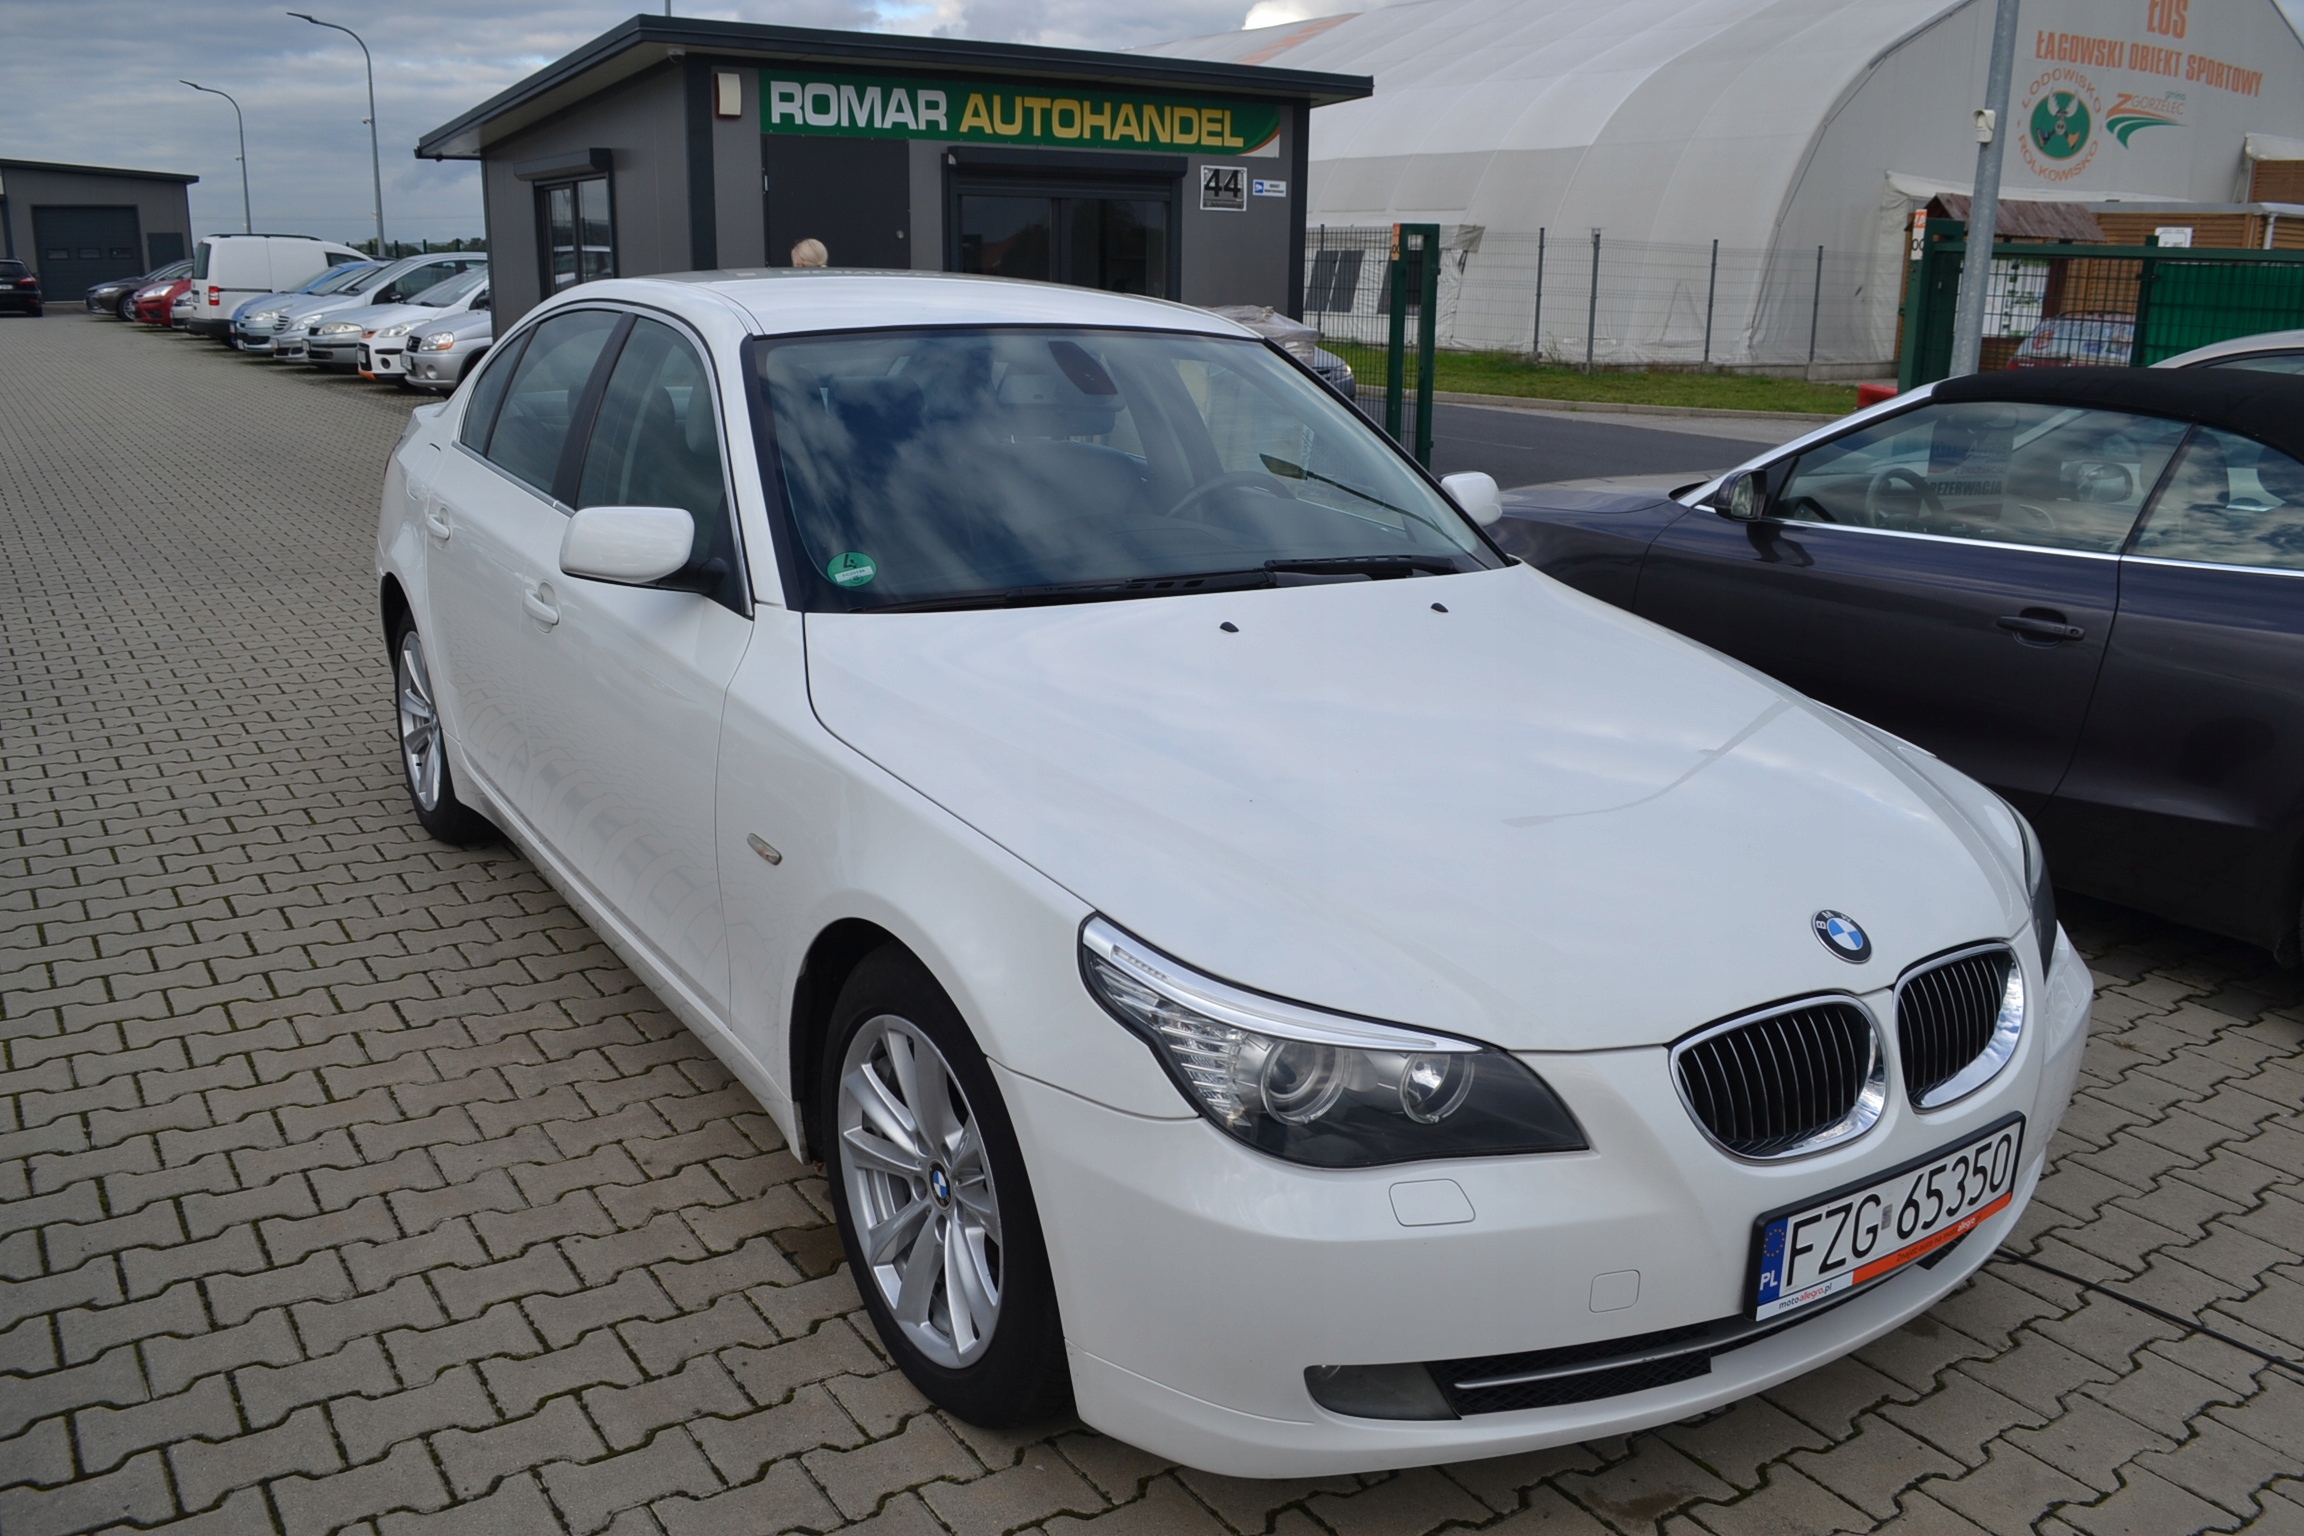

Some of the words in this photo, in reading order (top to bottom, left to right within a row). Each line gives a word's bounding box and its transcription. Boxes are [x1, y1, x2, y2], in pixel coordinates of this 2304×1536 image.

[2035, 30, 2125, 69] ŁAGOWSKI
[2129, 43, 2183, 78] OBIEKT
[2185, 54, 2264, 97] SPORTOWY
[770, 80, 948, 131] ROMAR
[958, 93, 1244, 148] AUTOHANDEL
[1204, 168, 1242, 198] 44
[843, 553, 858, 569] 4
[1815, 910, 1852, 930] BMW
[1785, 1193, 1882, 1288] FZG
[1896, 1133, 2012, 1240] 65350
[1760, 1269, 1779, 1291] PL
[1778, 1282, 1833, 1309] motoallegro.pl
